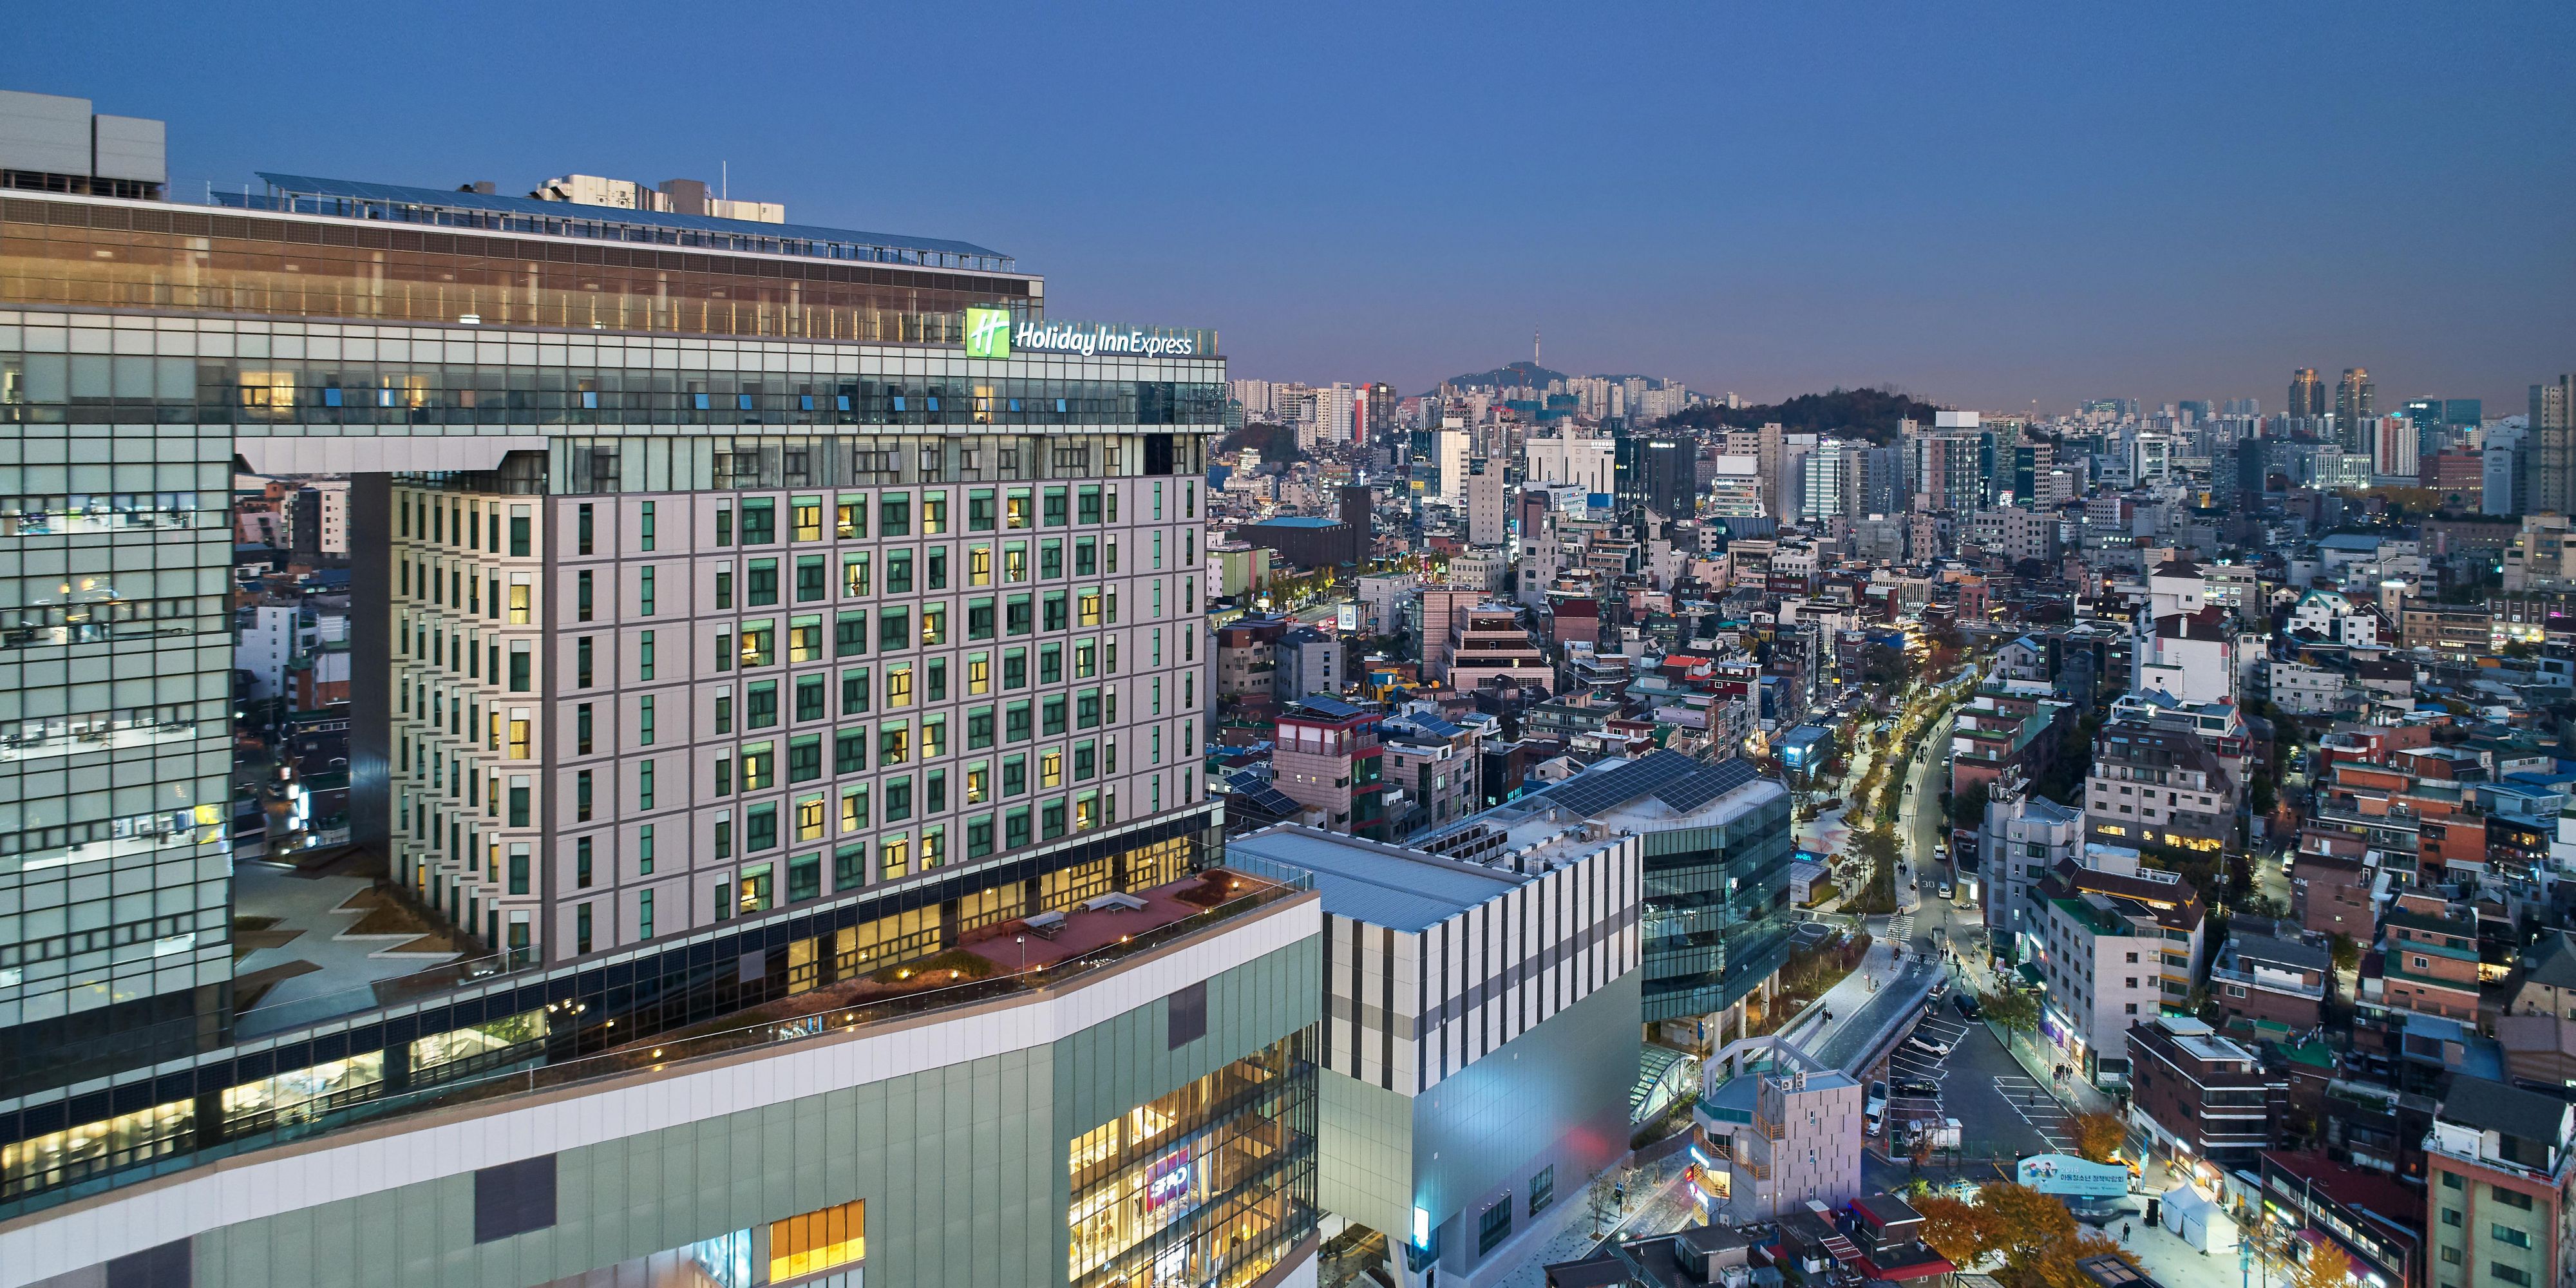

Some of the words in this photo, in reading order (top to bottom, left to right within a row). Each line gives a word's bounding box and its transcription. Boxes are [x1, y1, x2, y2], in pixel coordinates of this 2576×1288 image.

[1016, 322, 1096, 356] Holiday
[1099, 327, 1129, 352] Inn
[1131, 332, 1193, 358] Express
[2294, 877, 2308, 887] JM
